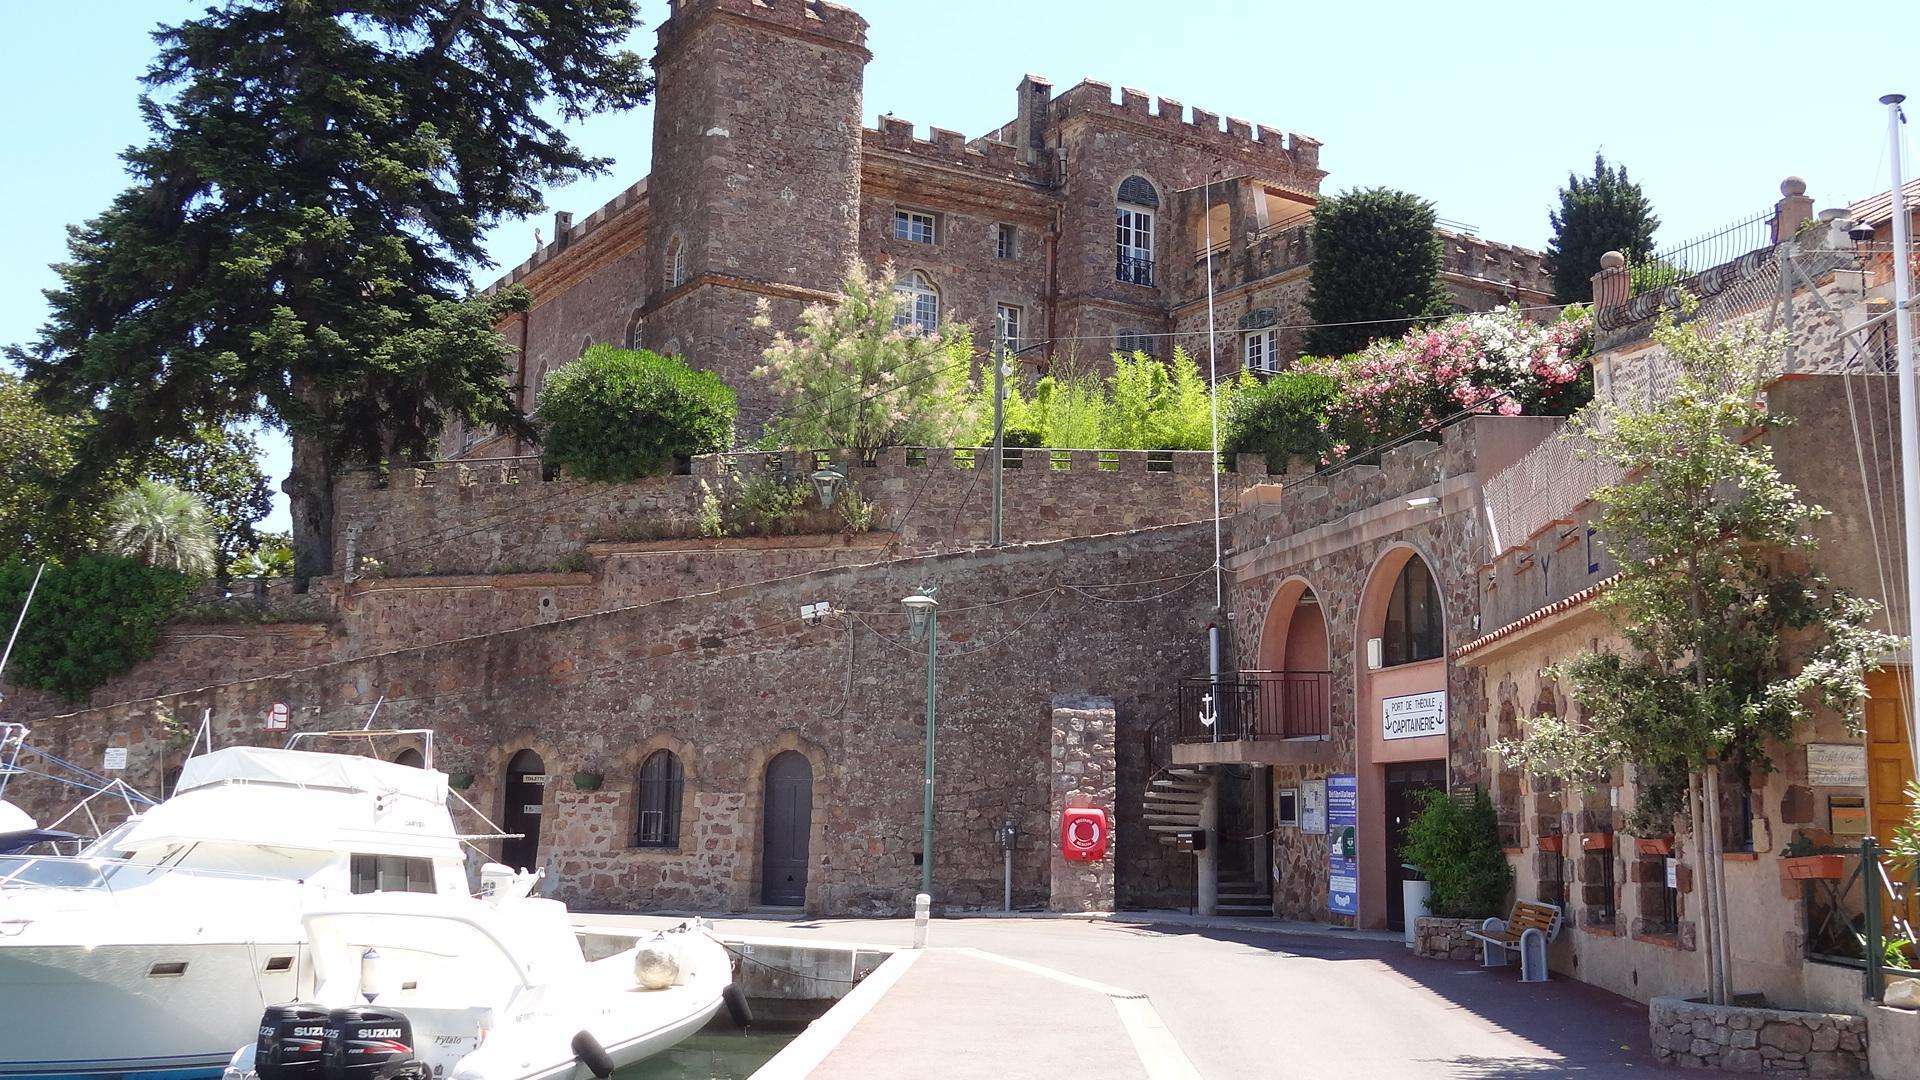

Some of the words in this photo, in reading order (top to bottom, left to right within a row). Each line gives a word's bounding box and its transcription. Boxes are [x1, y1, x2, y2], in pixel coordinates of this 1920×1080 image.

[1391, 701, 1403, 712] PORT
[1406, 700, 1412, 710] DE
[1392, 716, 1435, 734] CAPITAINERIE
[260, 1026, 275, 1037] 225
[358, 1028, 401, 1038] SUZUKI
